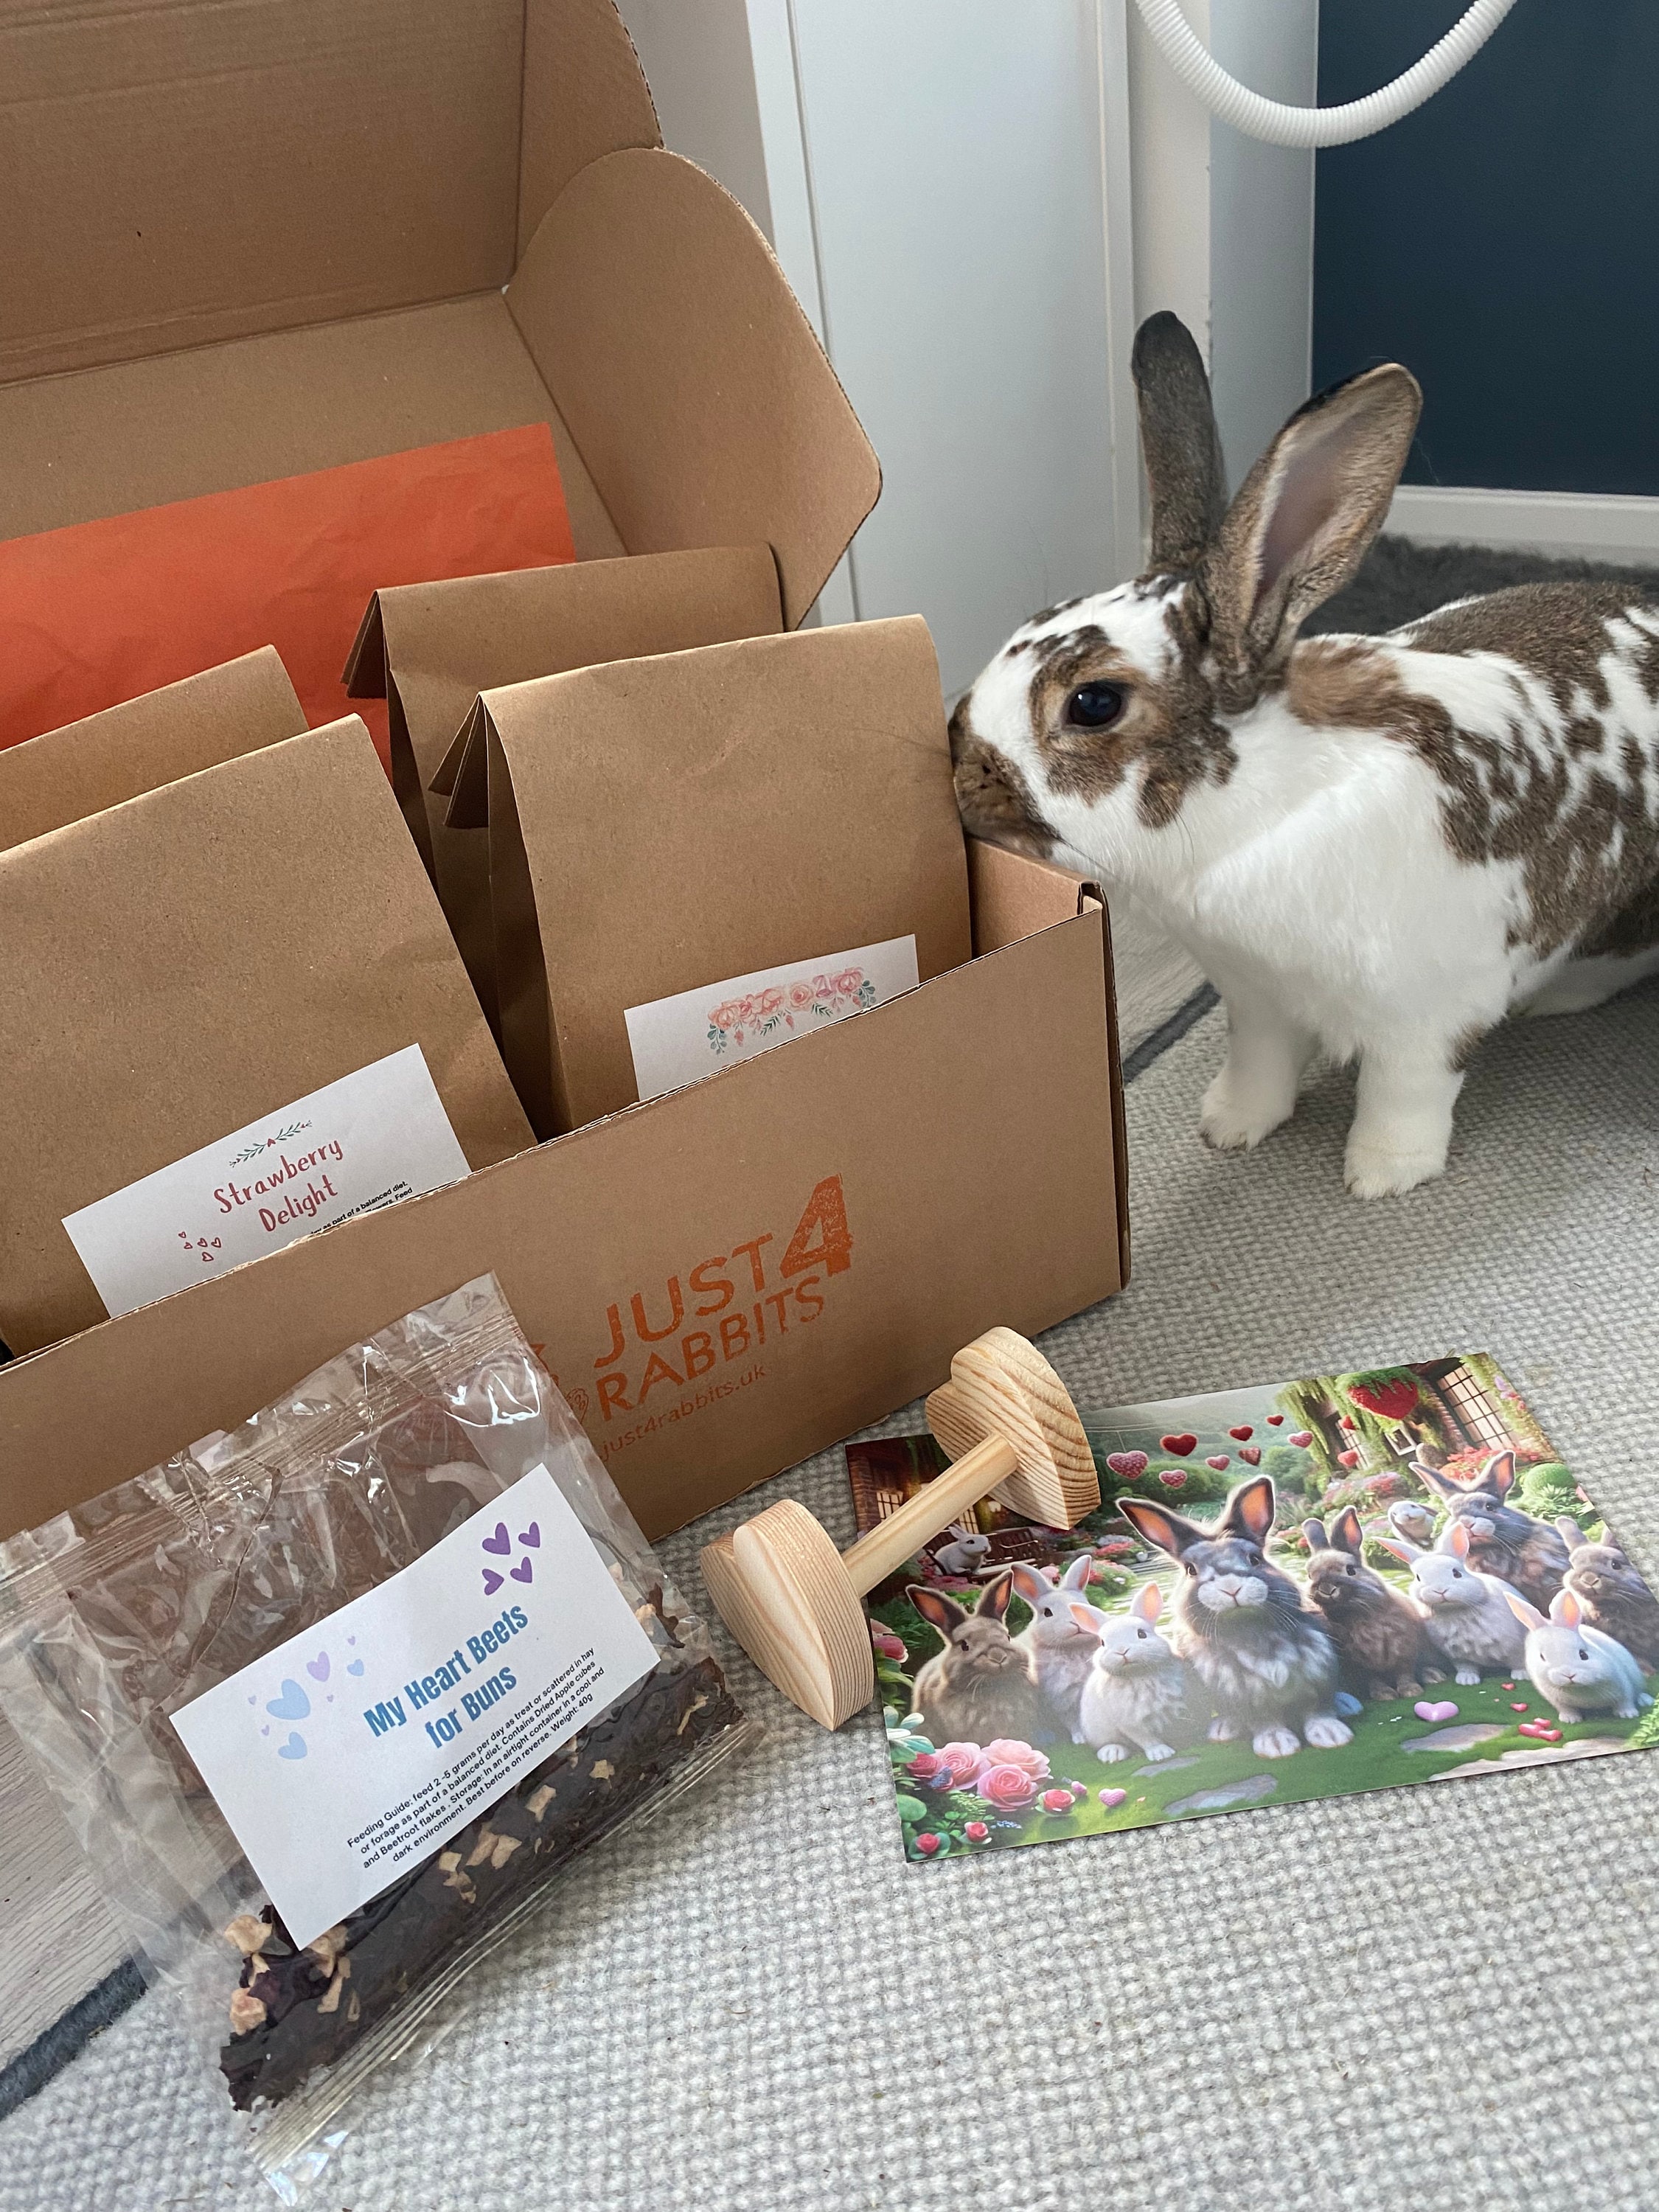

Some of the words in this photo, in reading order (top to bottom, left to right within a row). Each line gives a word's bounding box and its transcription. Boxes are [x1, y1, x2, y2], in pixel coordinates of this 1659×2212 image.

[213, 1139, 344, 1214] Strawberry
[258, 1174, 338, 1232] Delight
[332, 1214, 347, 1225] part
[347, 1208, 355, 1217] of
[360, 1188, 392, 1209] balanced
[392, 1180, 408, 1192] diet.
[394, 1187, 413, 1200] Feed
[596, 1275, 825, 1422] RABBITS
[363, 1696, 407, 1738] My
[403, 1649, 472, 1711] Heart
[465, 1605, 529, 1664] Beets
[425, 1708, 463, 1748] for
[460, 1666, 517, 1722] Buns
[347, 1819, 384, 1848] Feeding
[383, 1799, 413, 1821] Guide:
[412, 1782, 434, 1801] feed
[451, 1751, 476, 1775] grams
[476, 1739, 490, 1755] per
[490, 1726, 504, 1741] day
[505, 1718, 515, 1729] as
[514, 1701, 534, 1720] treat
[533, 1694, 542, 1705] or
[543, 1664, 575, 1697] scattered
[574, 1659, 582, 1668] in
[580, 1647, 594, 1662] hay
[361, 1843, 370, 1854] or
[370, 1823, 400, 1846] forage
[401, 1815, 413, 1826] as
[412, 1799, 432, 1819] part
[431, 1791, 442, 1804] of
[442, 1788, 448, 1796] a
[447, 1756, 485, 1790] balanced
[484, 1744, 502, 1760] diet.
[501, 1716, 535, 1745] Contains
[534, 1697, 555, 1718] Dried
[554, 1680, 575, 1701] Apple
[574, 1661, 596, 1682] cubes
[364, 1851, 380, 1868] and
[379, 1823, 420, 1855] Beetroot
[419, 1805, 446, 1827] flakes
[450, 1774, 484, 1804] Storage:
[483, 1767, 493, 1776] In
[493, 1758, 503, 1770] an
[503, 1734, 529, 1761] airtight
[529, 1705, 563, 1737] container
[562, 1700, 571, 1708] in
[576, 1679, 591, 1697] cool
[591, 1666, 605, 1683] and
[393, 1844, 414, 1862] dark
[413, 1804, 467, 1847] environment.
[465, 1787, 485, 1806] Best
[484, 1766, 511, 1790] before
[511, 1756, 522, 1767] on
[521, 1732, 552, 1759] reverse.
[550, 1706, 580, 1732] Weight:
[579, 1693, 594, 1708] 40g
